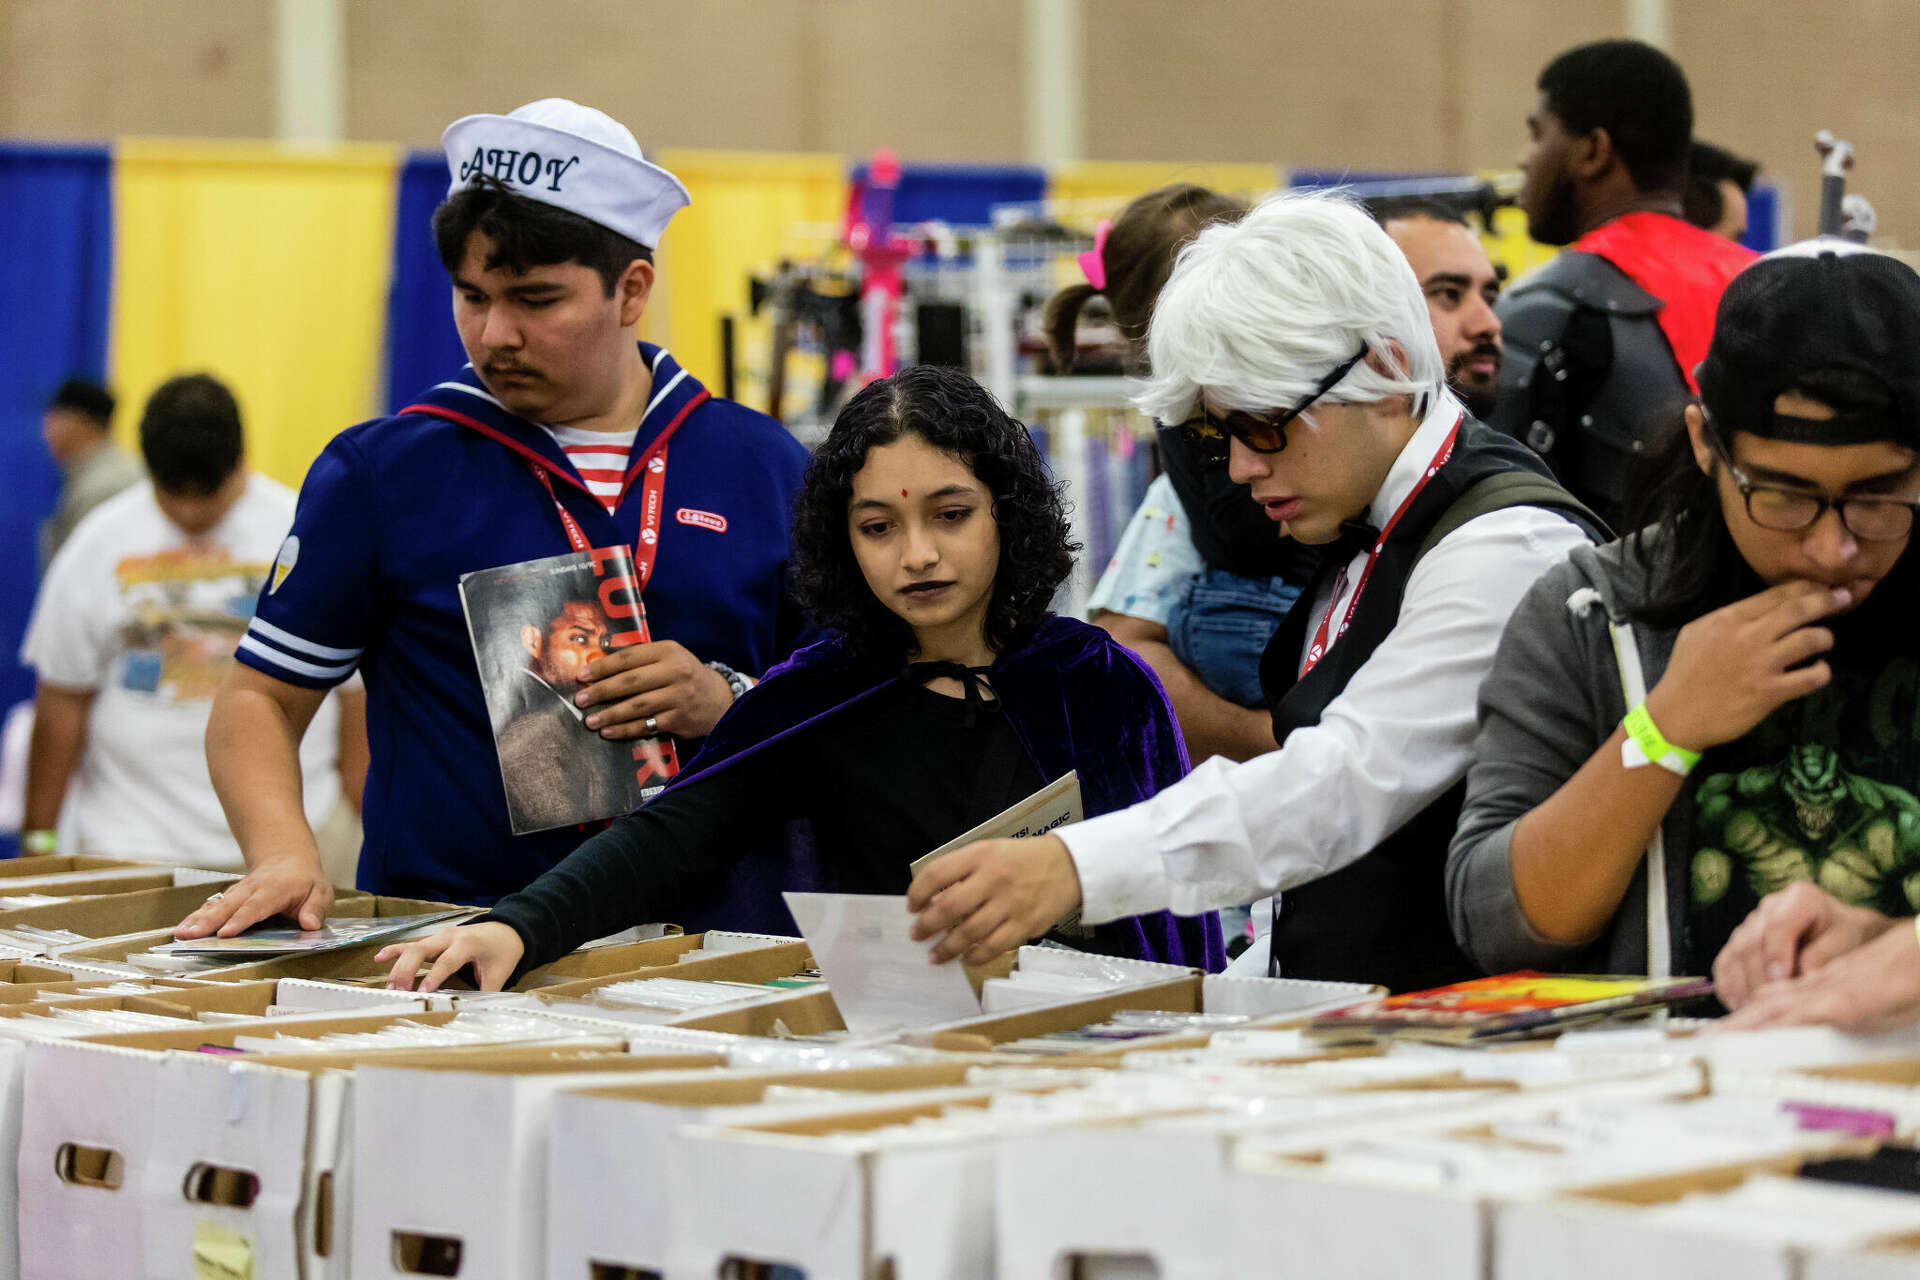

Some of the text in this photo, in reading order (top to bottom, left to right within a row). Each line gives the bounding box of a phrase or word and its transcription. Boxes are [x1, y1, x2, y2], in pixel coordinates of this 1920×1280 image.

[460, 147, 580, 192] AHOY
[647, 489, 658, 526] VITECH
[591, 545, 680, 787] LUTR
